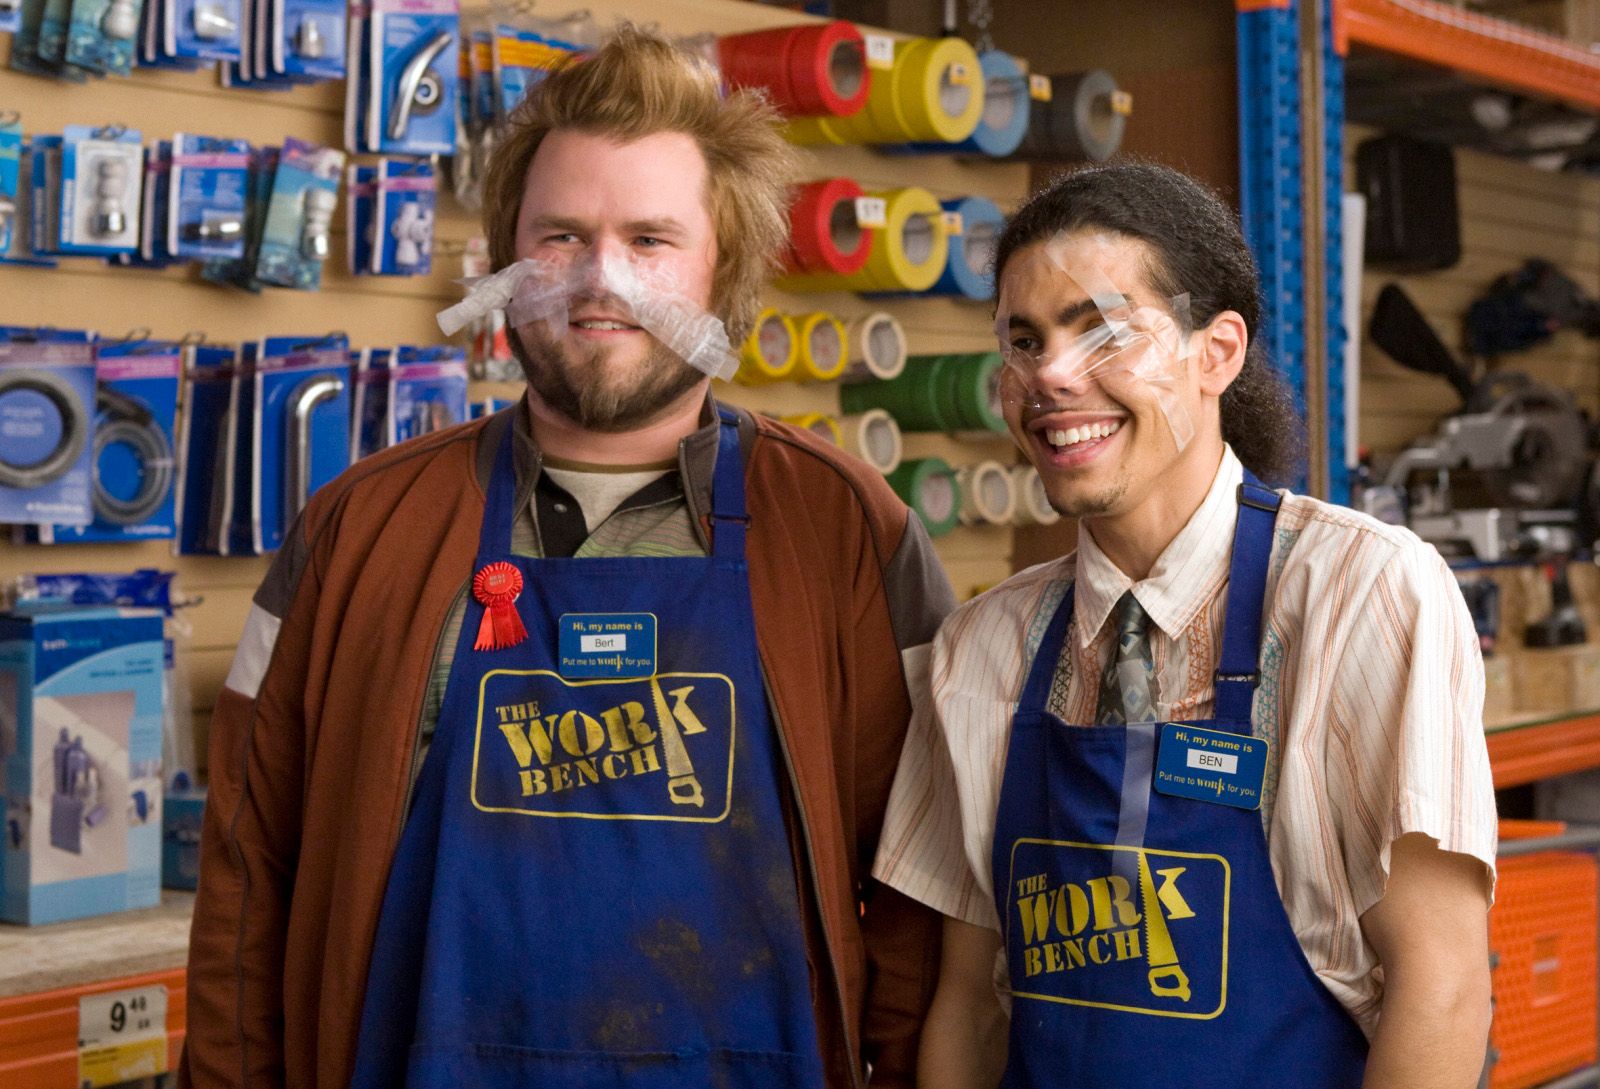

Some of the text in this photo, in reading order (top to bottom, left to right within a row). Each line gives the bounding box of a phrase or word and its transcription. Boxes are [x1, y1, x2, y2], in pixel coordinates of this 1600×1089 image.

[573, 622, 586, 631] Hi,
[589, 624, 603, 632] my
[635, 622, 643, 631] is
[595, 638, 614, 648] Bert
[563, 658, 575, 666] Put
[496, 701, 540, 722] THE
[499, 685, 707, 767] WORK
[1176, 732, 1253, 753] Hi, my name is
[518, 745, 661, 796] BENCH
[1199, 755, 1223, 767] BEN
[1159, 771, 1172, 781] Put
[1174, 774, 1186, 784] me
[1188, 777, 1195, 785] to
[1228, 783, 1239, 793] for
[1017, 873, 1047, 897] THE
[1017, 867, 1196, 946] WORK
[1024, 928, 1143, 977] BENCH
